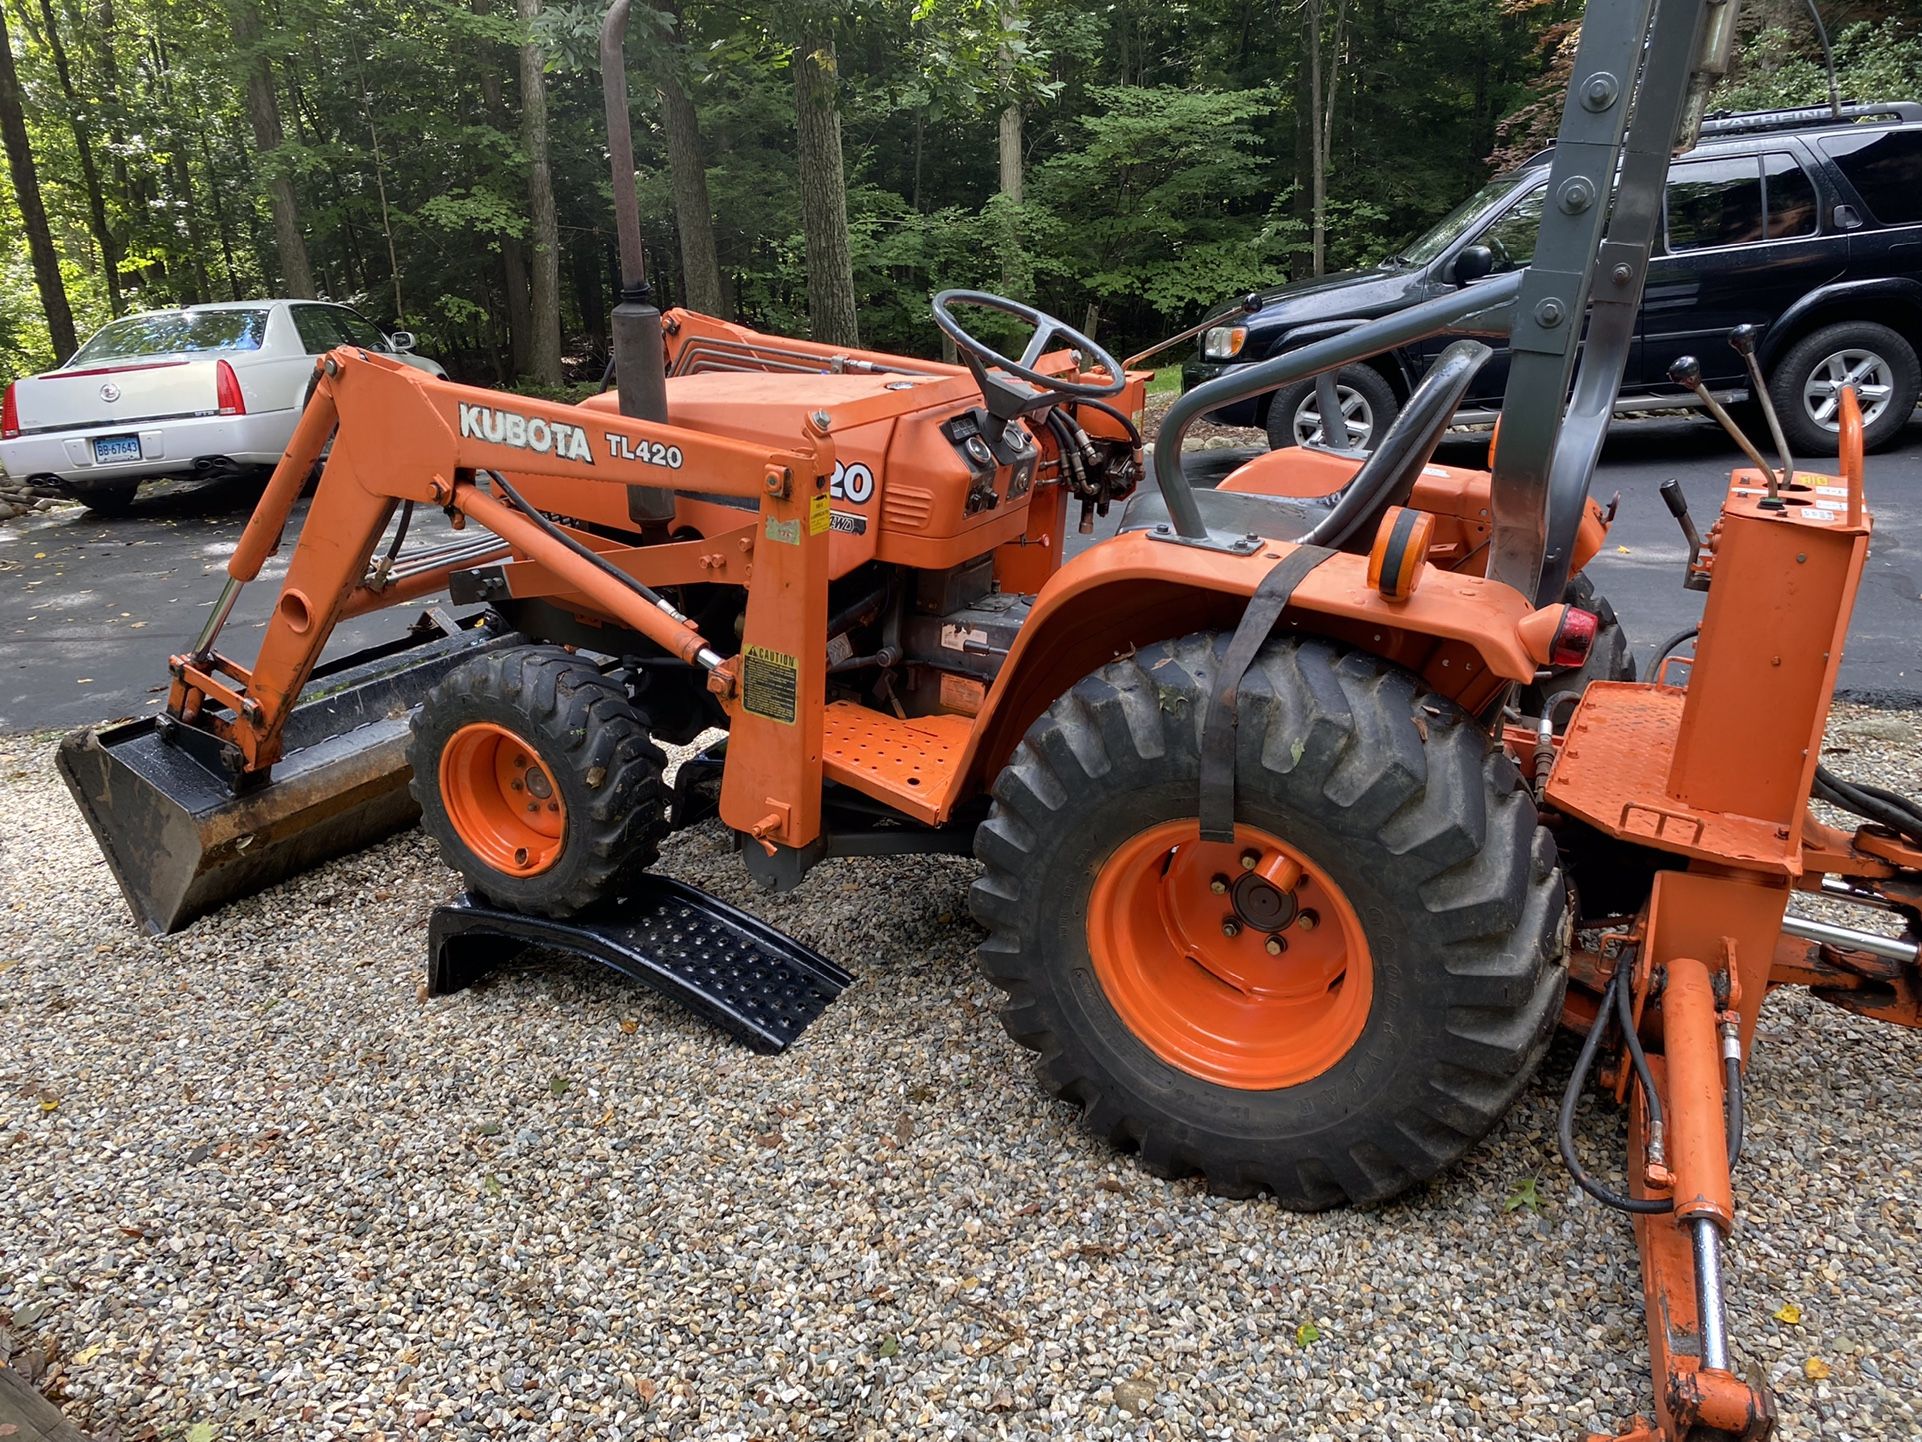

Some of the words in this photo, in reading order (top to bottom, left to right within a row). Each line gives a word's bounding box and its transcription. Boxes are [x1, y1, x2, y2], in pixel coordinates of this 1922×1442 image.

[1714, 105, 1872, 129] PATHFINDER
[458, 402, 595, 465] KUBOTA
[604, 432, 684, 469] TL420
[759, 648, 795, 667] CAUTION
